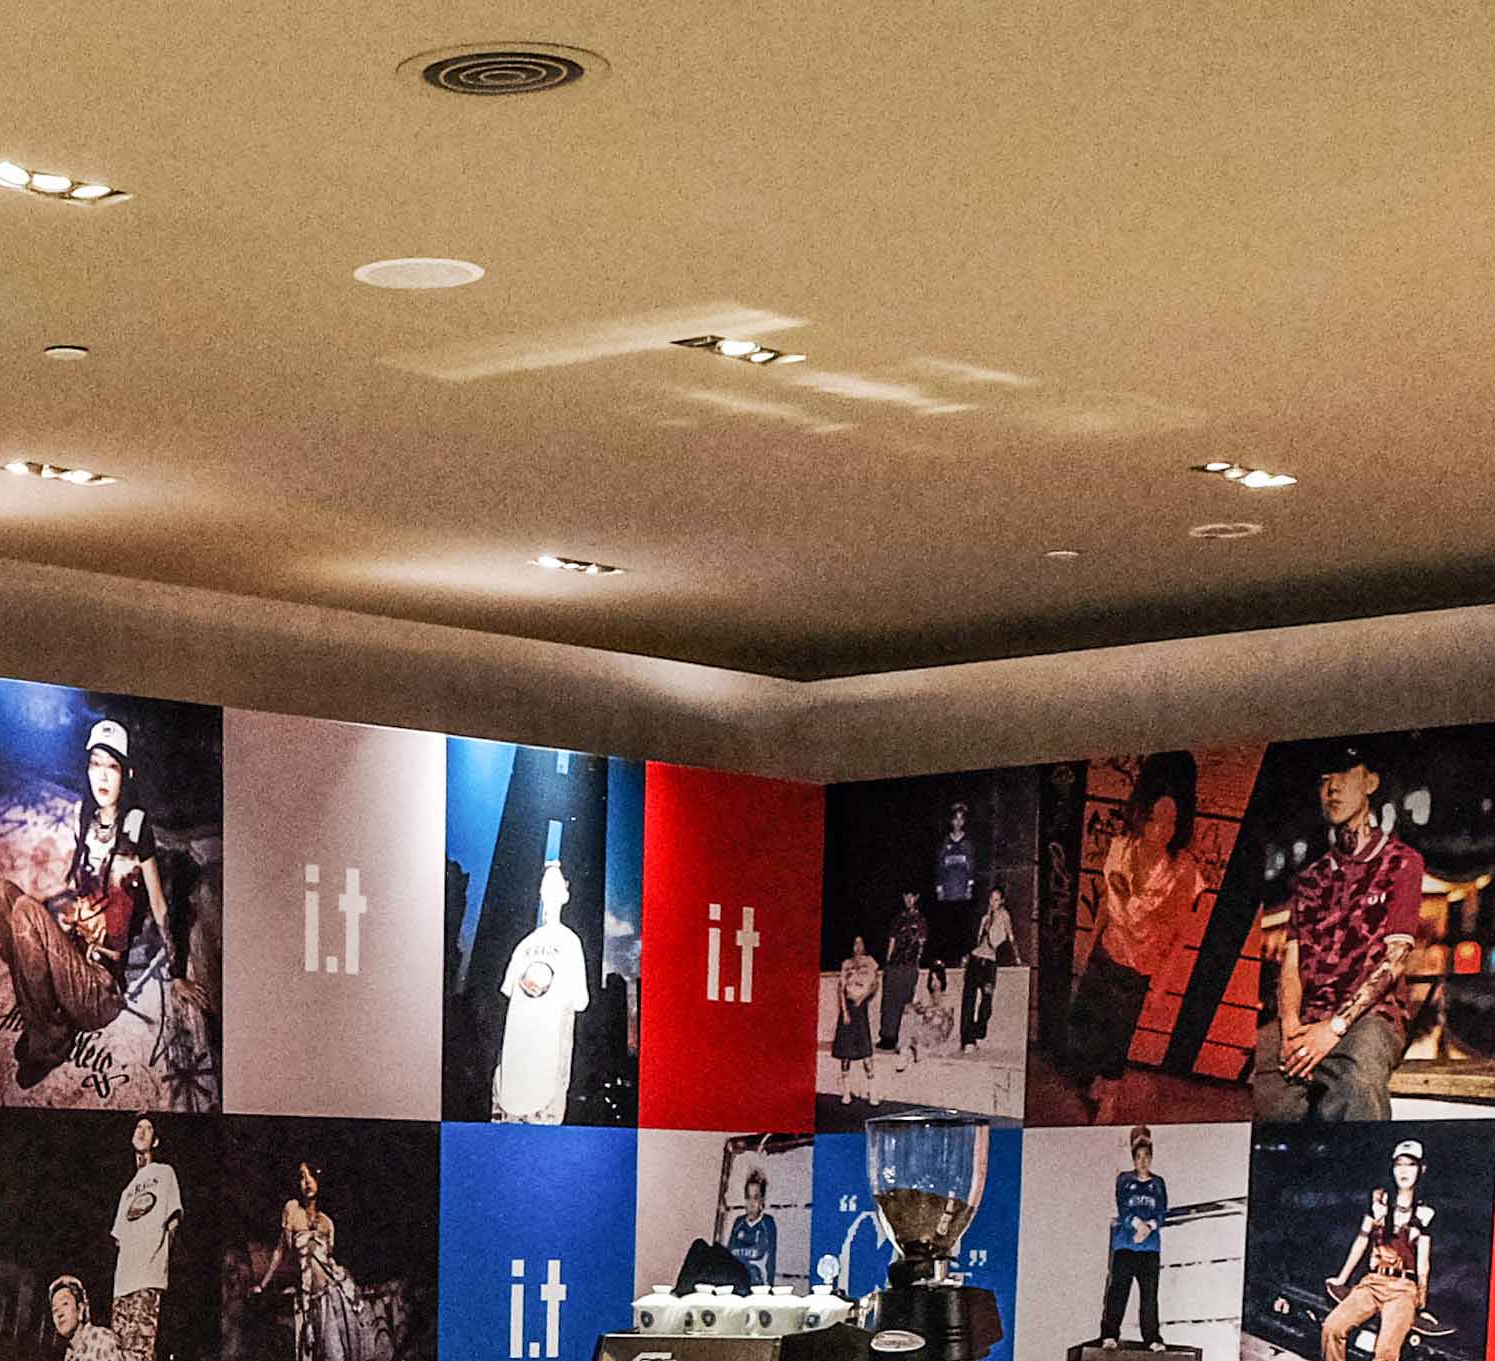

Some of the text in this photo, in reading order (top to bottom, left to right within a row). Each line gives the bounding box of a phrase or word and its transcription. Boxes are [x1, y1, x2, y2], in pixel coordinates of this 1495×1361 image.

[304, 863, 368, 974] i.t
[706, 902, 761, 1004] i.t
[508, 1257, 568, 1359] i.t
